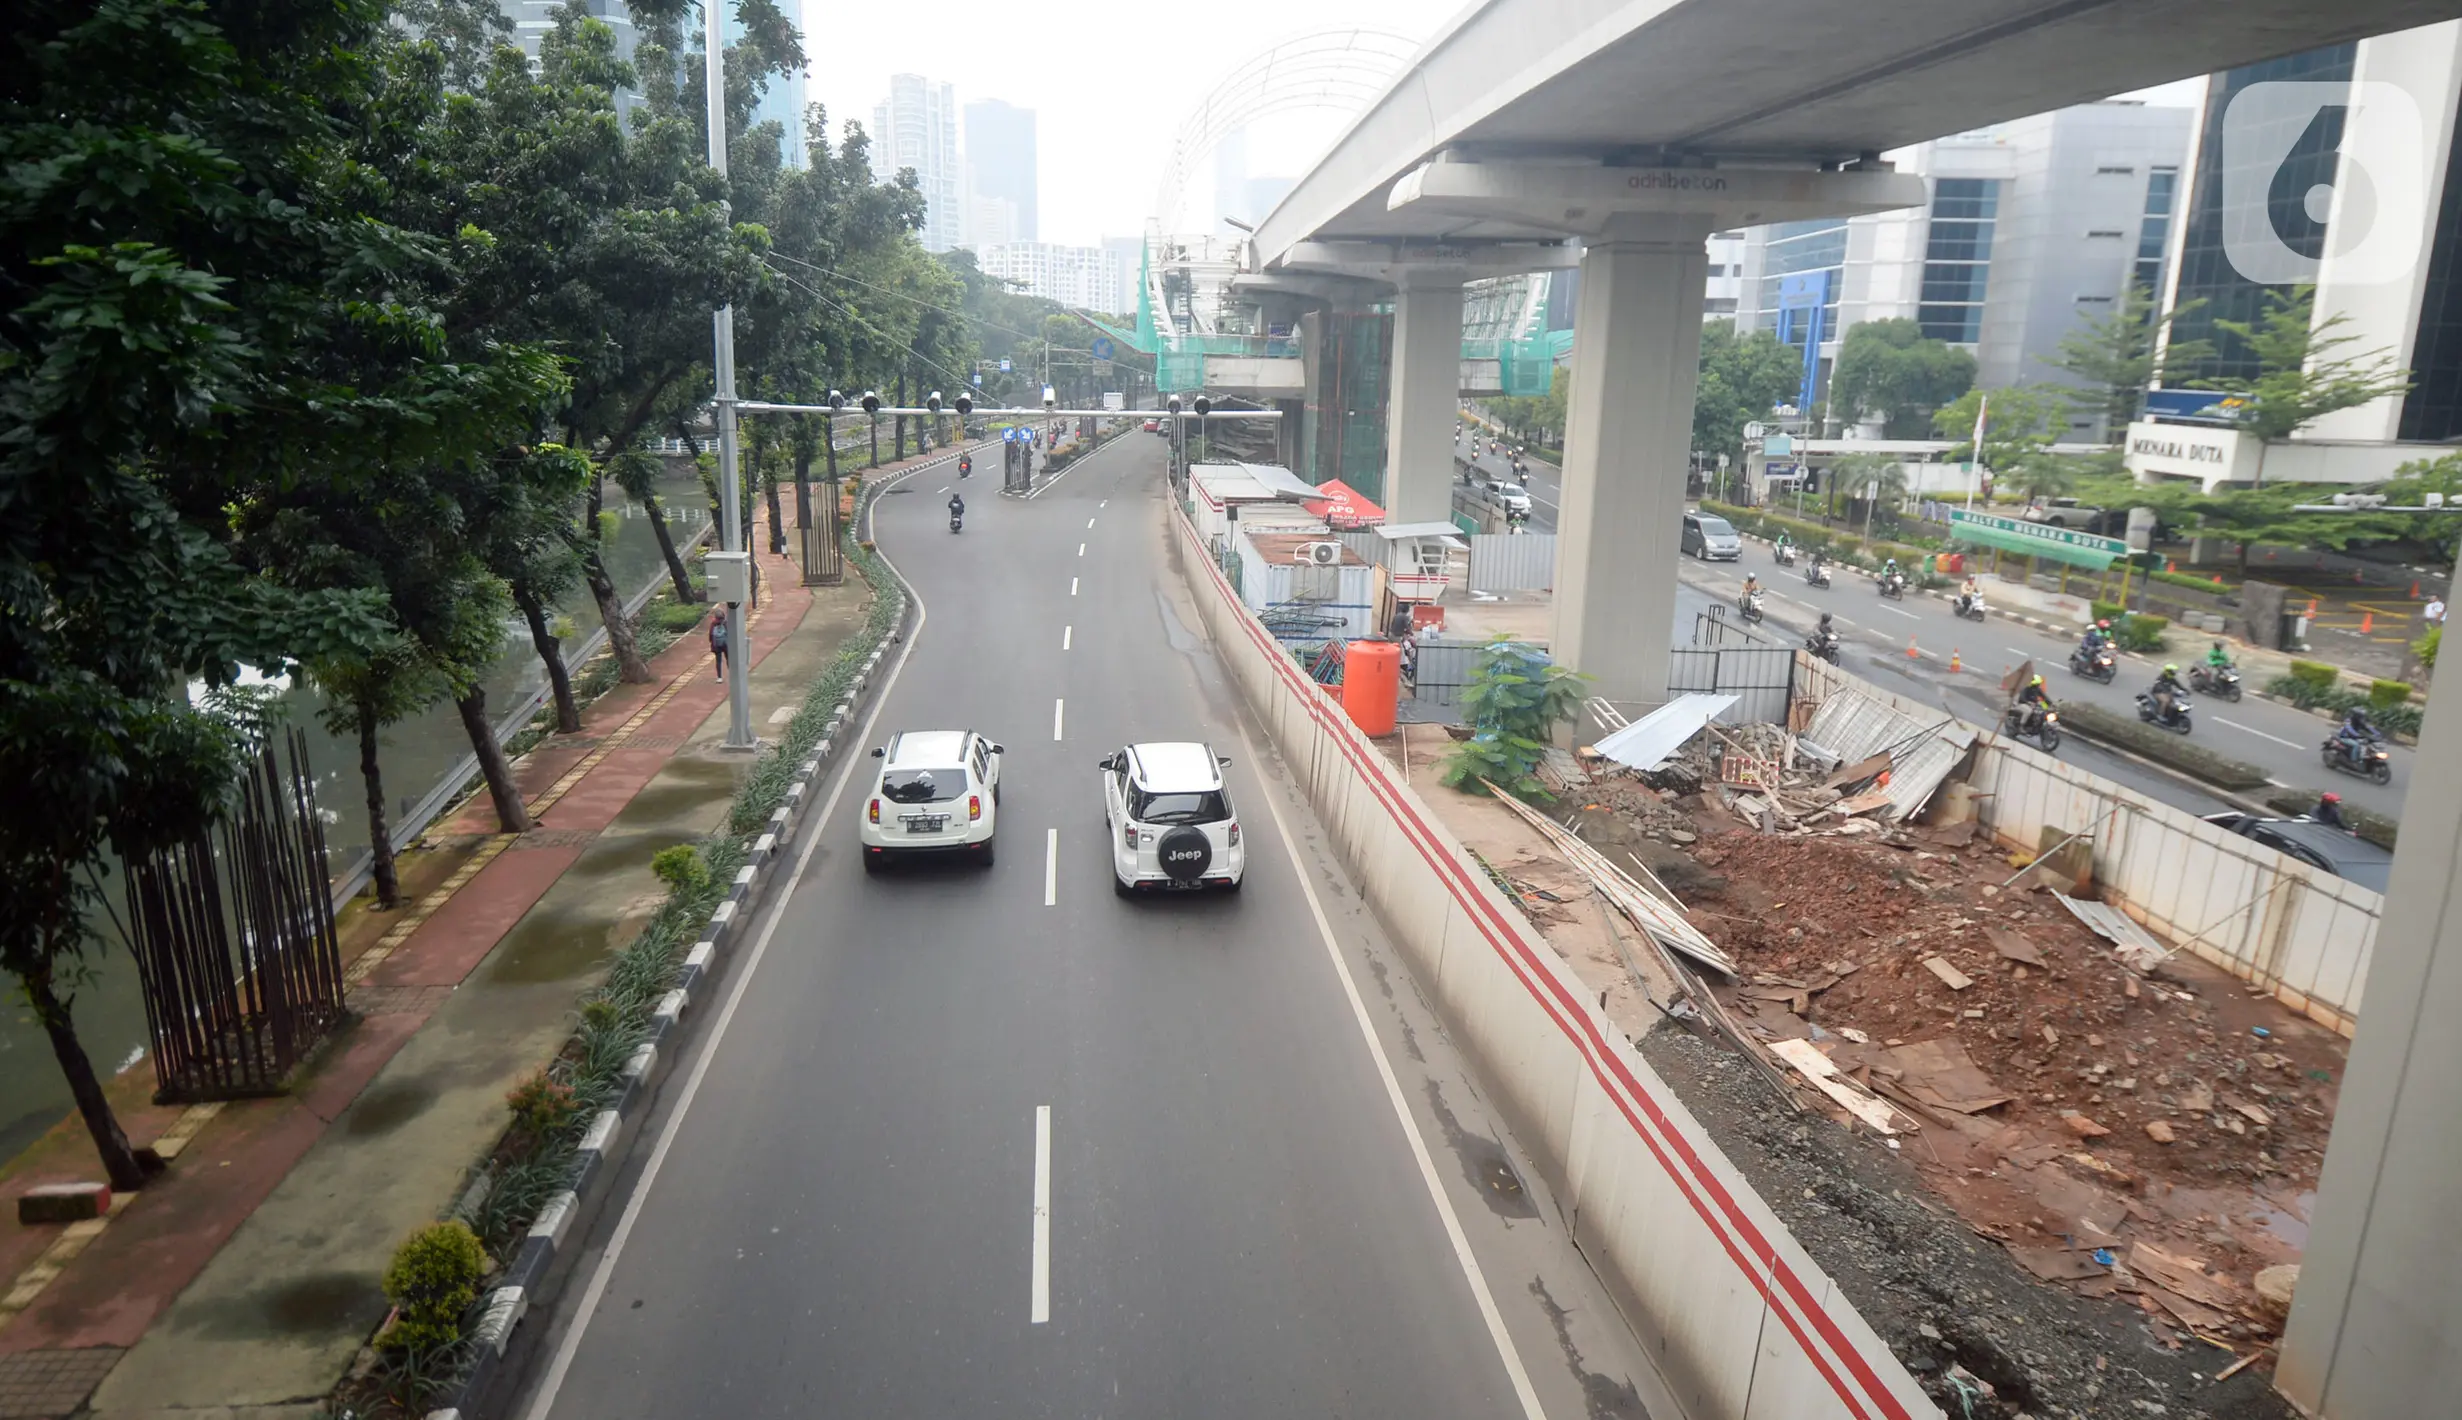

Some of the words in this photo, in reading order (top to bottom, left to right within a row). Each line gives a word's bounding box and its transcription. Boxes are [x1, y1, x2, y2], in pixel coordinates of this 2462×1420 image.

[2133, 438, 2182, 459] MENARA
[2189, 443, 2223, 463] DUTA
[1963, 512, 2000, 529] HALTE
[2013, 523, 2066, 542] MENARA
[2071, 535, 2109, 550] DUTA
[1168, 850, 1202, 861] Jeep
